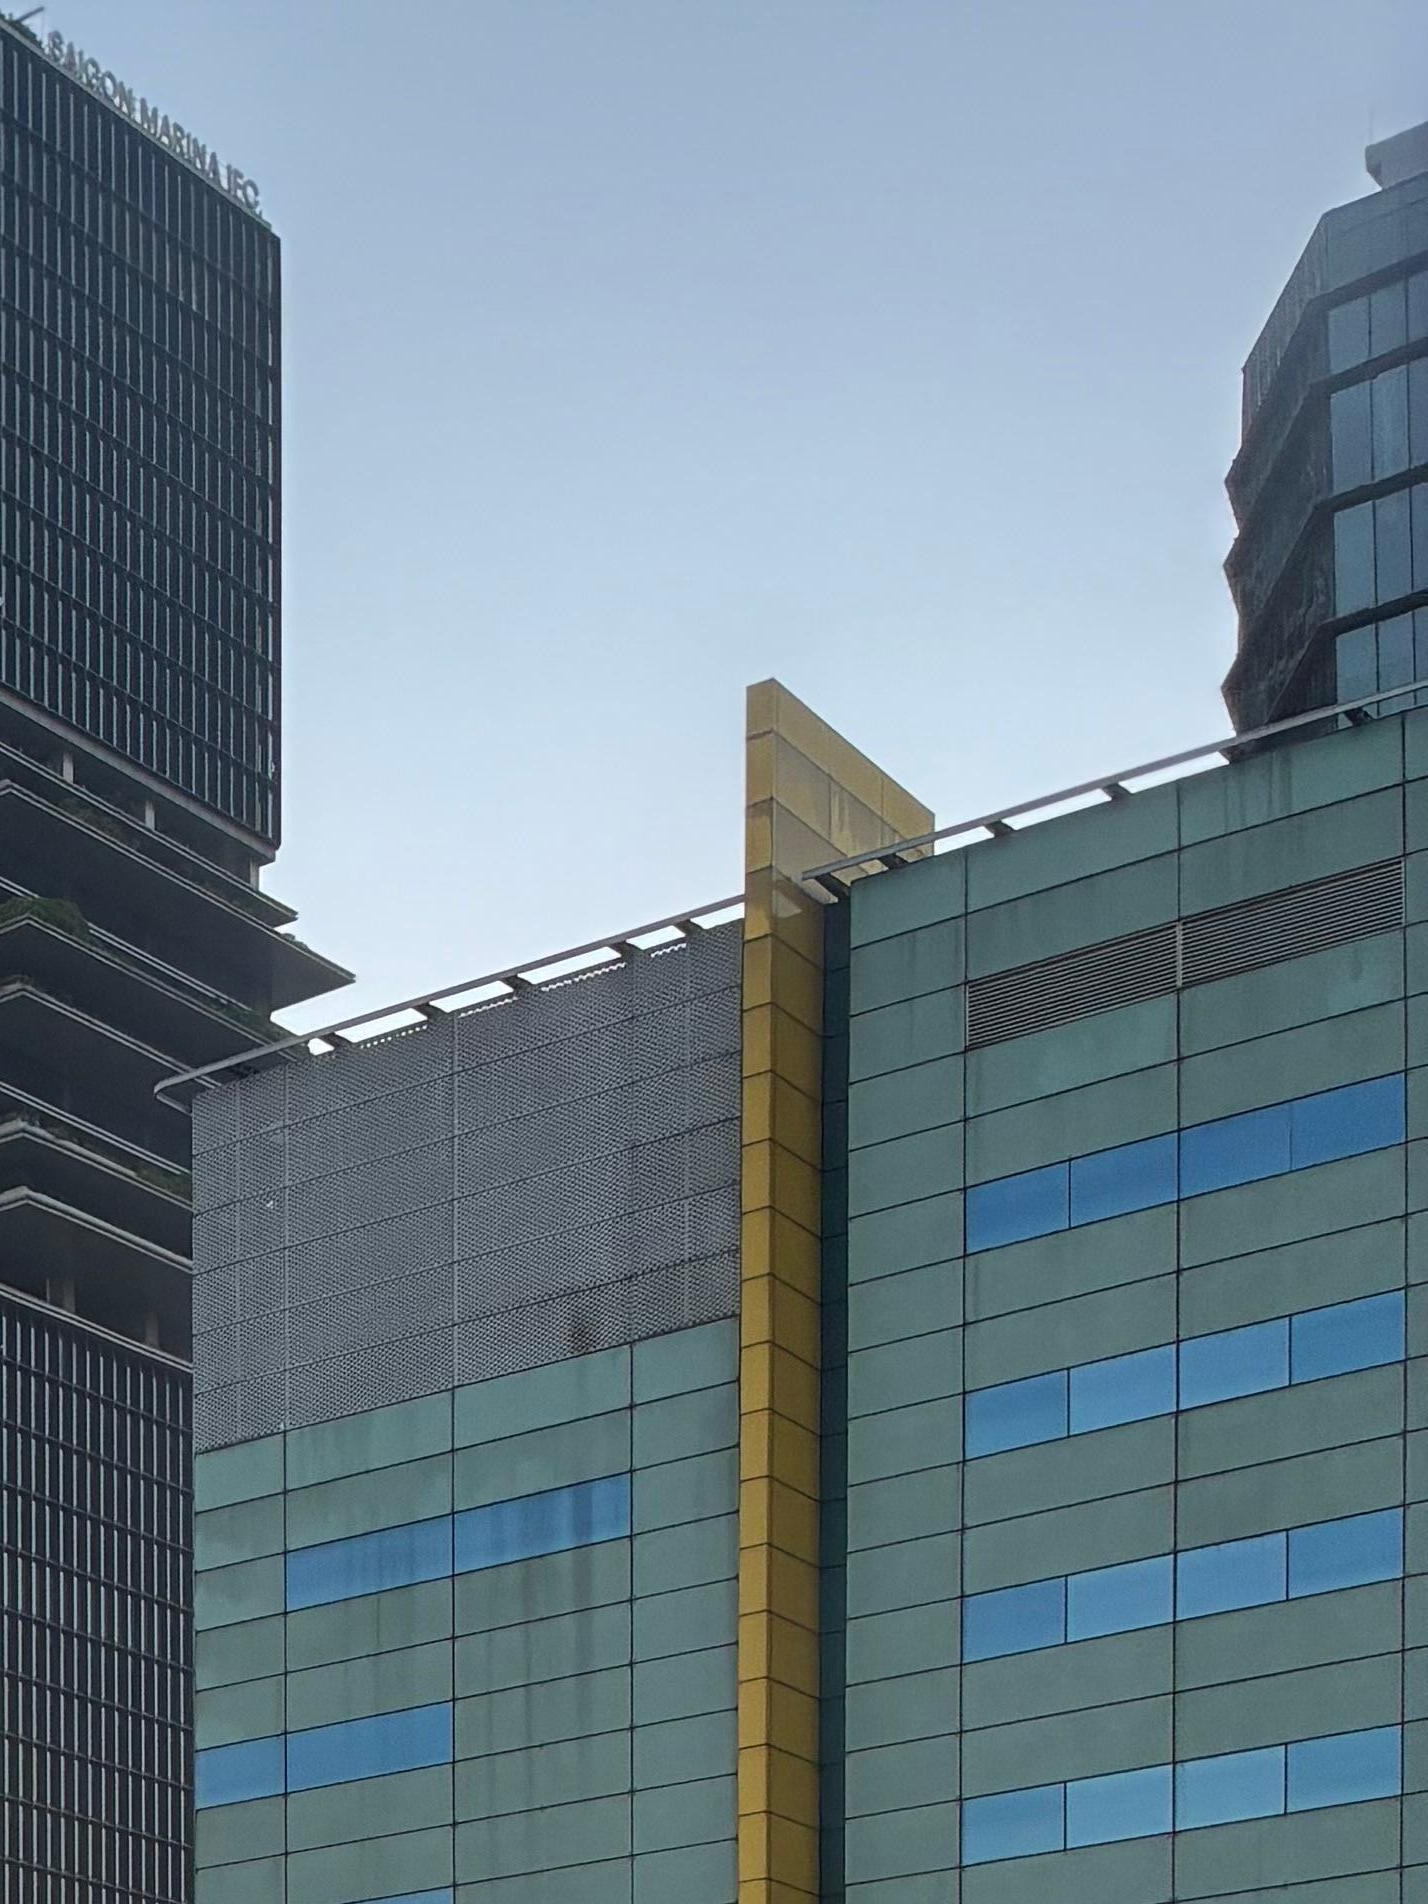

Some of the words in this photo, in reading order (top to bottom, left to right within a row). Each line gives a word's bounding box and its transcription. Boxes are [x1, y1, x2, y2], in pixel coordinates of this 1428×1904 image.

[47, 30, 135, 119] SAIGON
[140, 97, 223, 188] MARINA
[225, 163, 261, 209] IFC
